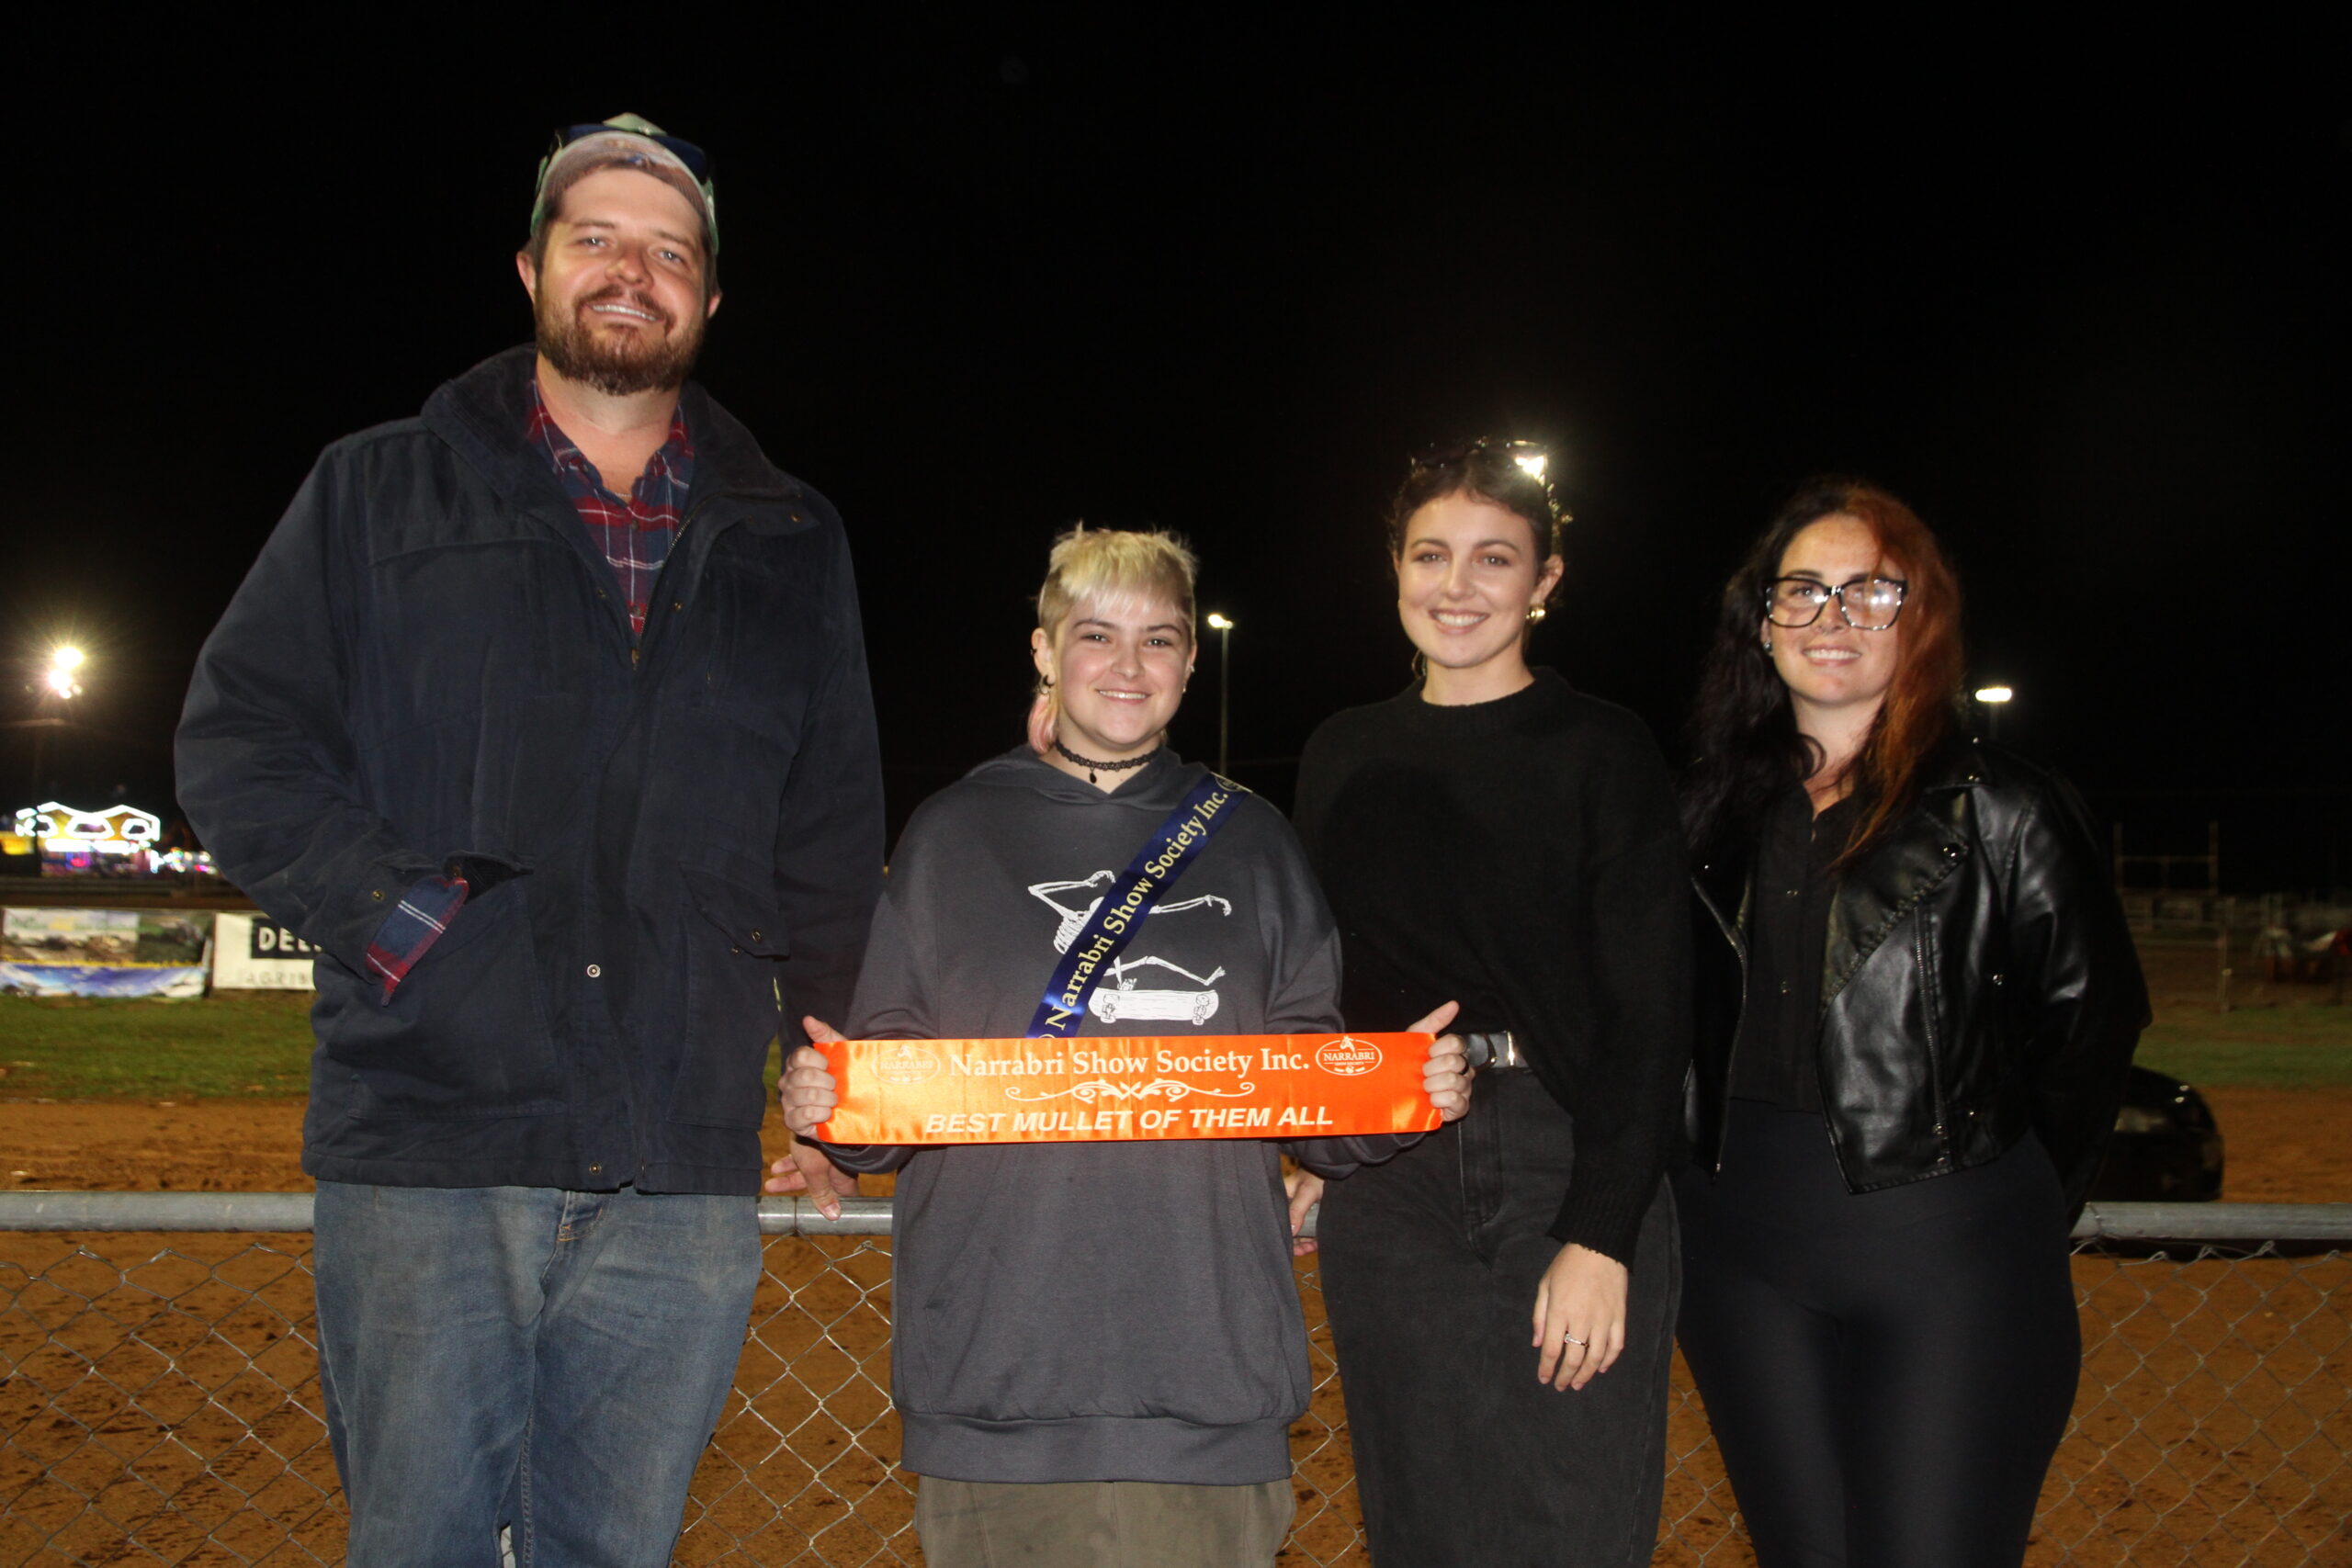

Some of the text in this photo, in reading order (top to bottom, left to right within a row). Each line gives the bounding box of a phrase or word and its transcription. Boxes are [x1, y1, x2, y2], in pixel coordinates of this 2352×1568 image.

[1045, 790, 1229, 1030] Narrabri Show Society Inc.
[258, 927, 322, 952] DEL
[949, 1048, 1310, 1078] Narrabri Show Society Inc.
[1323, 1052, 1375, 1061] NARRABRI
[926, 1106, 1333, 1134] BEST MULLET OF THEM ALL
